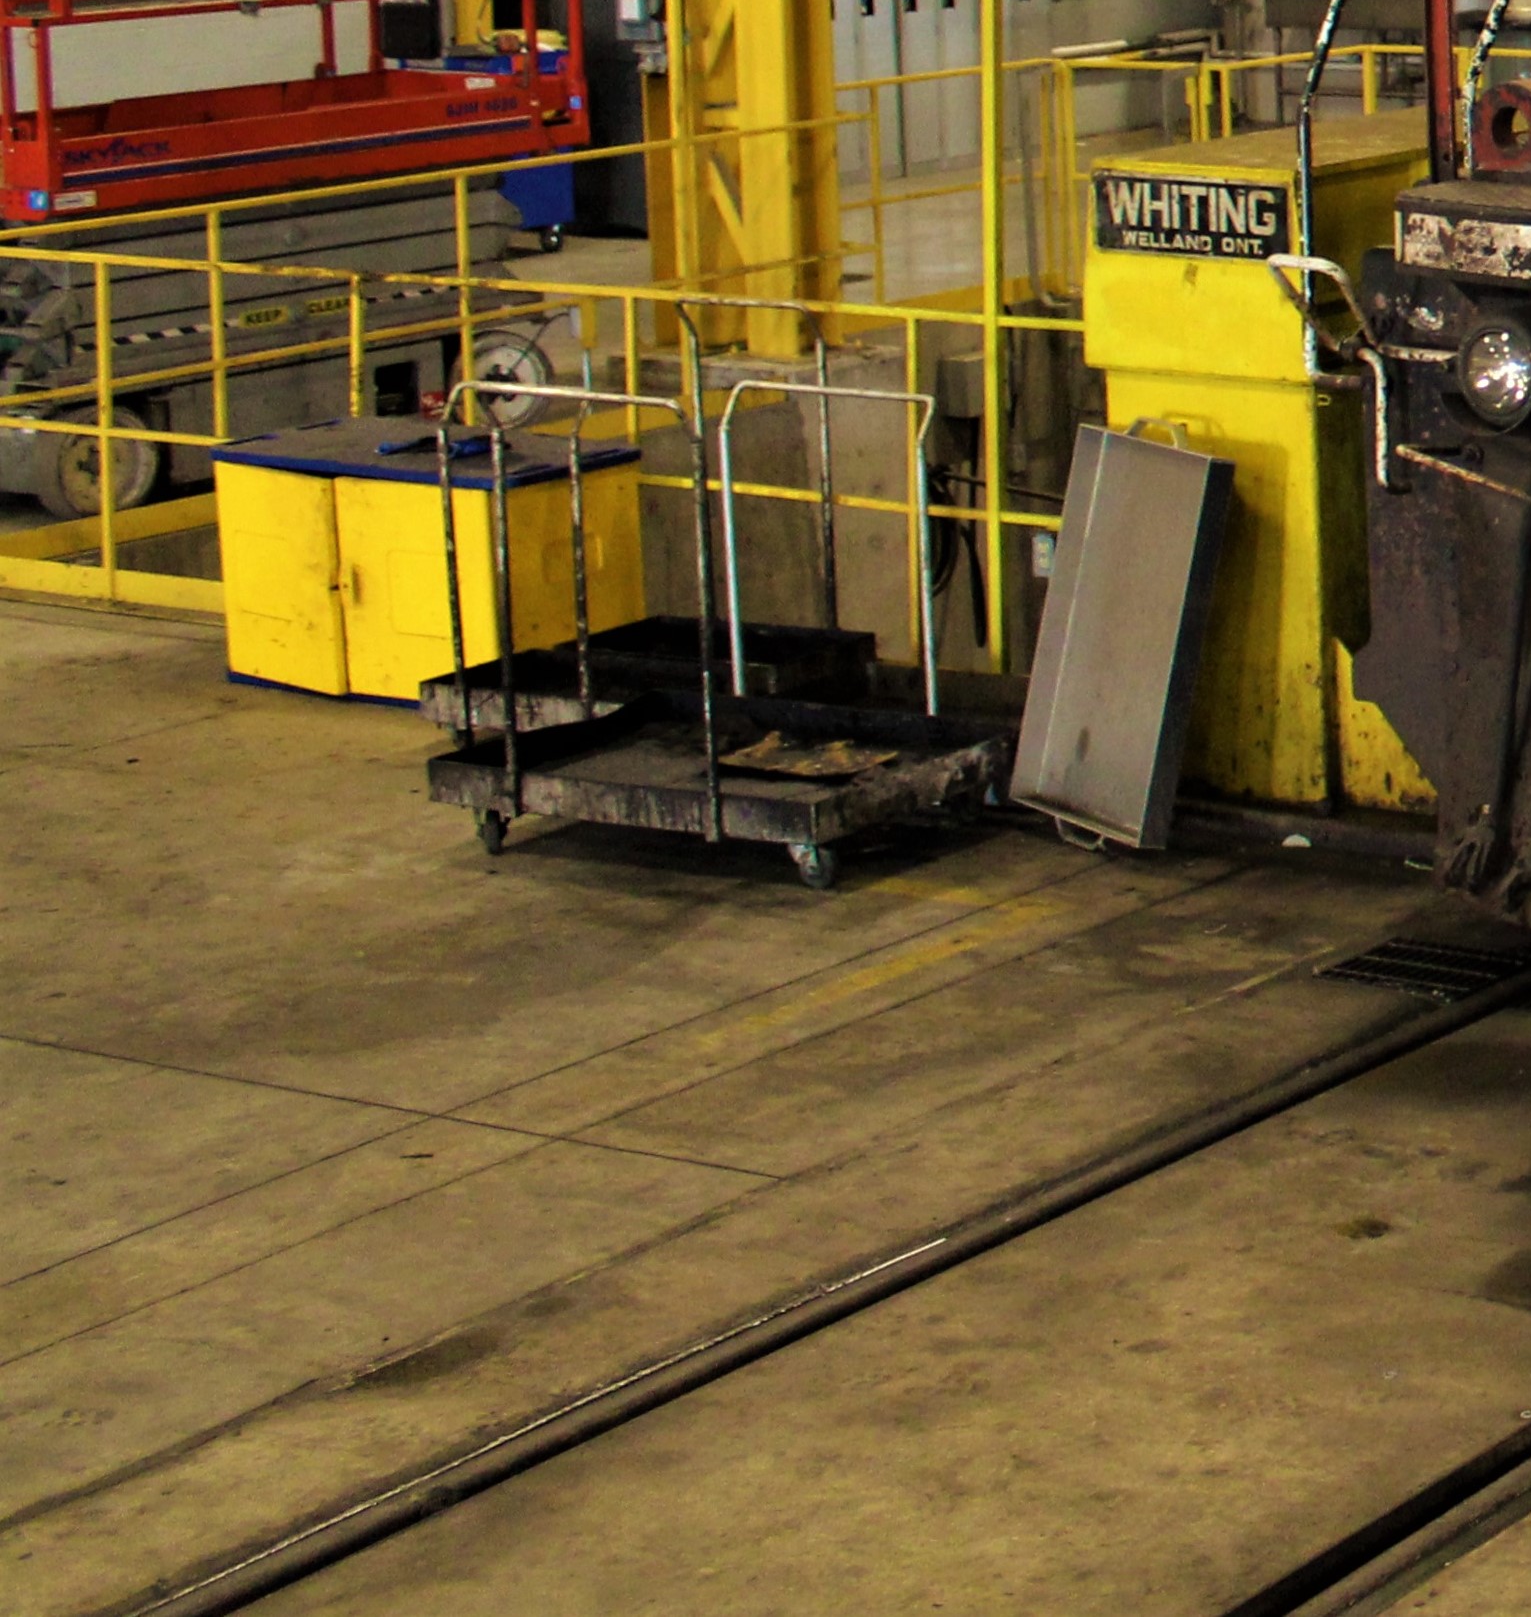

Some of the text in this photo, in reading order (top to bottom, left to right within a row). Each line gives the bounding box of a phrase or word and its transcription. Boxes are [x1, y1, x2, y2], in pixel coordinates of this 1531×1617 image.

[1105, 179, 1277, 236] WHITING
[1122, 230, 1263, 255] WELLAND ONT.
[245, 308, 282, 325] KEEP
